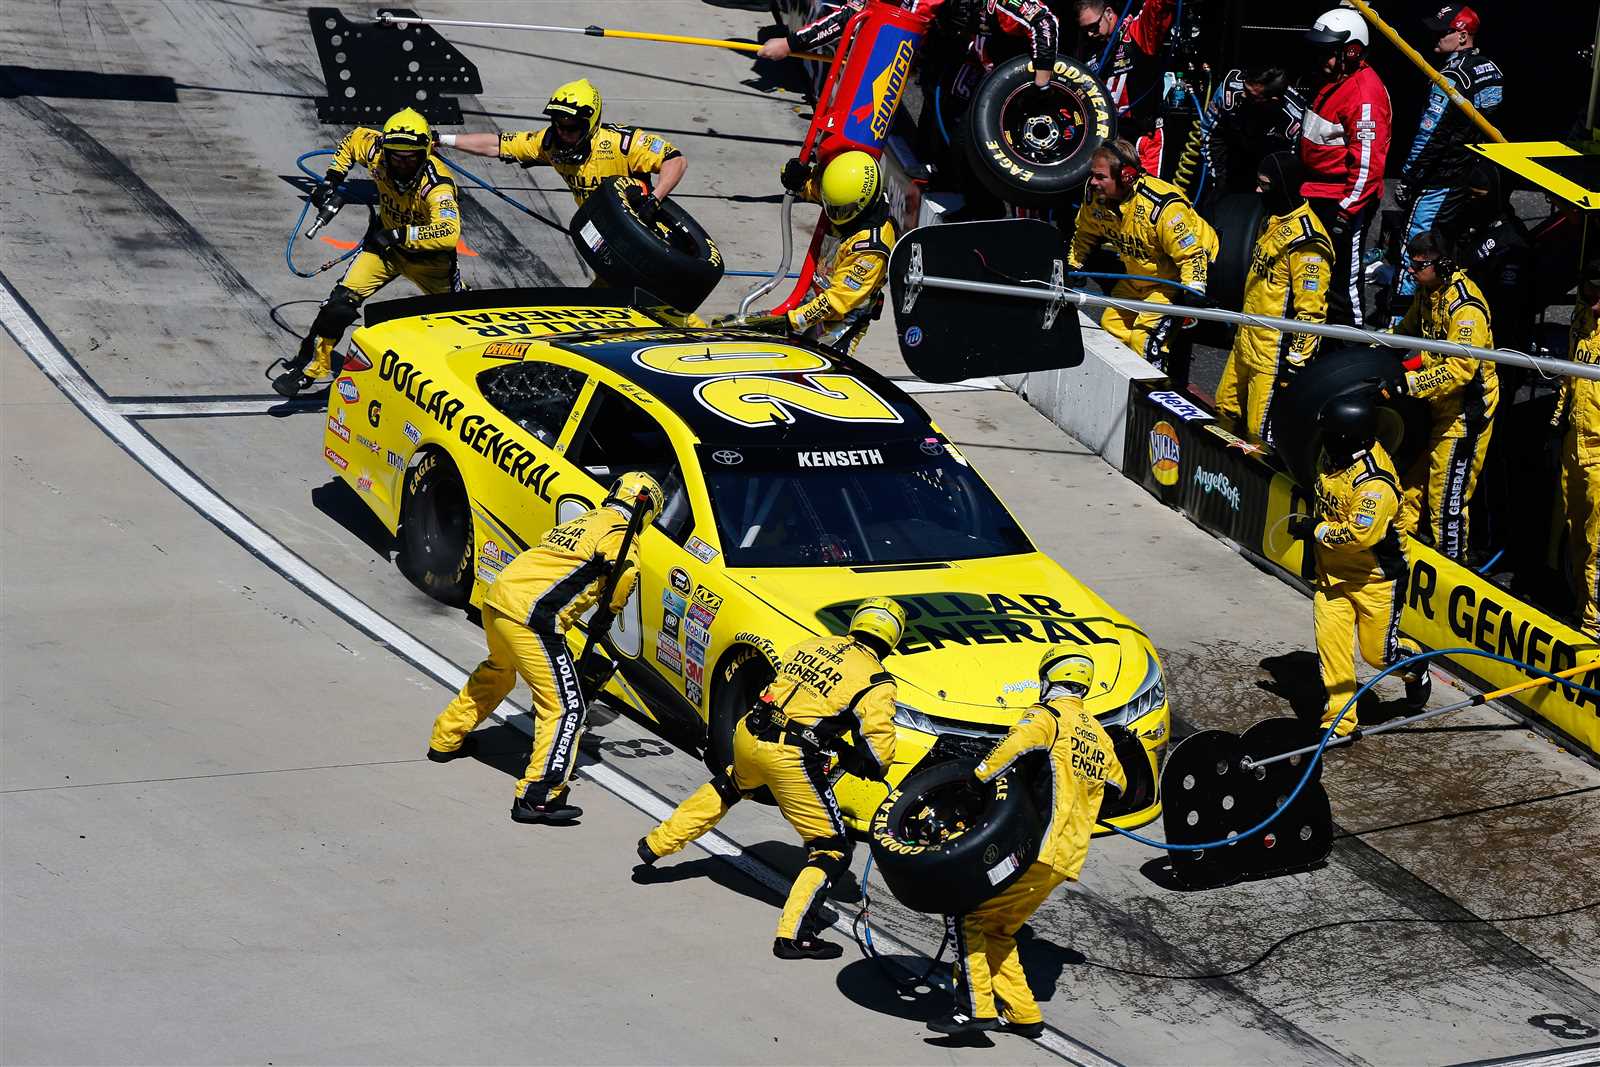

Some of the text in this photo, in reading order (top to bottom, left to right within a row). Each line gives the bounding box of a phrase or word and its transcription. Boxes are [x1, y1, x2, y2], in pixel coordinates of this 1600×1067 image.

[873, 43, 913, 139] SUNOCO
[1027, 61, 1109, 139] ODYEAR
[985, 140, 1035, 182] EAGLE
[861, 166, 870, 194] DOLLAR
[436, 308, 628, 325] GENERAL
[487, 343, 530, 357] DEWALT
[1151, 391, 1203, 422] Hefty
[379, 349, 561, 504] DOLLAR GENERAL
[409, 454, 438, 496] EAGLE
[797, 449, 885, 467] KENSETH
[1447, 459, 1467, 558] OLLAR GENERAL
[548, 534, 578, 552] ERAL
[816, 646, 844, 665] ROYER
[889, 619, 1121, 656] ENERAL
[686, 658, 703, 686] 3M
[724, 646, 758, 682] EAGLE
[784, 662, 834, 698] GENERAL
[794, 650, 843, 685] DOLLAR
[551, 654, 579, 771] DOLLAR GENERAL
[995, 777, 1009, 801] GLE
[873, 789, 926, 855] GOODYEAR
